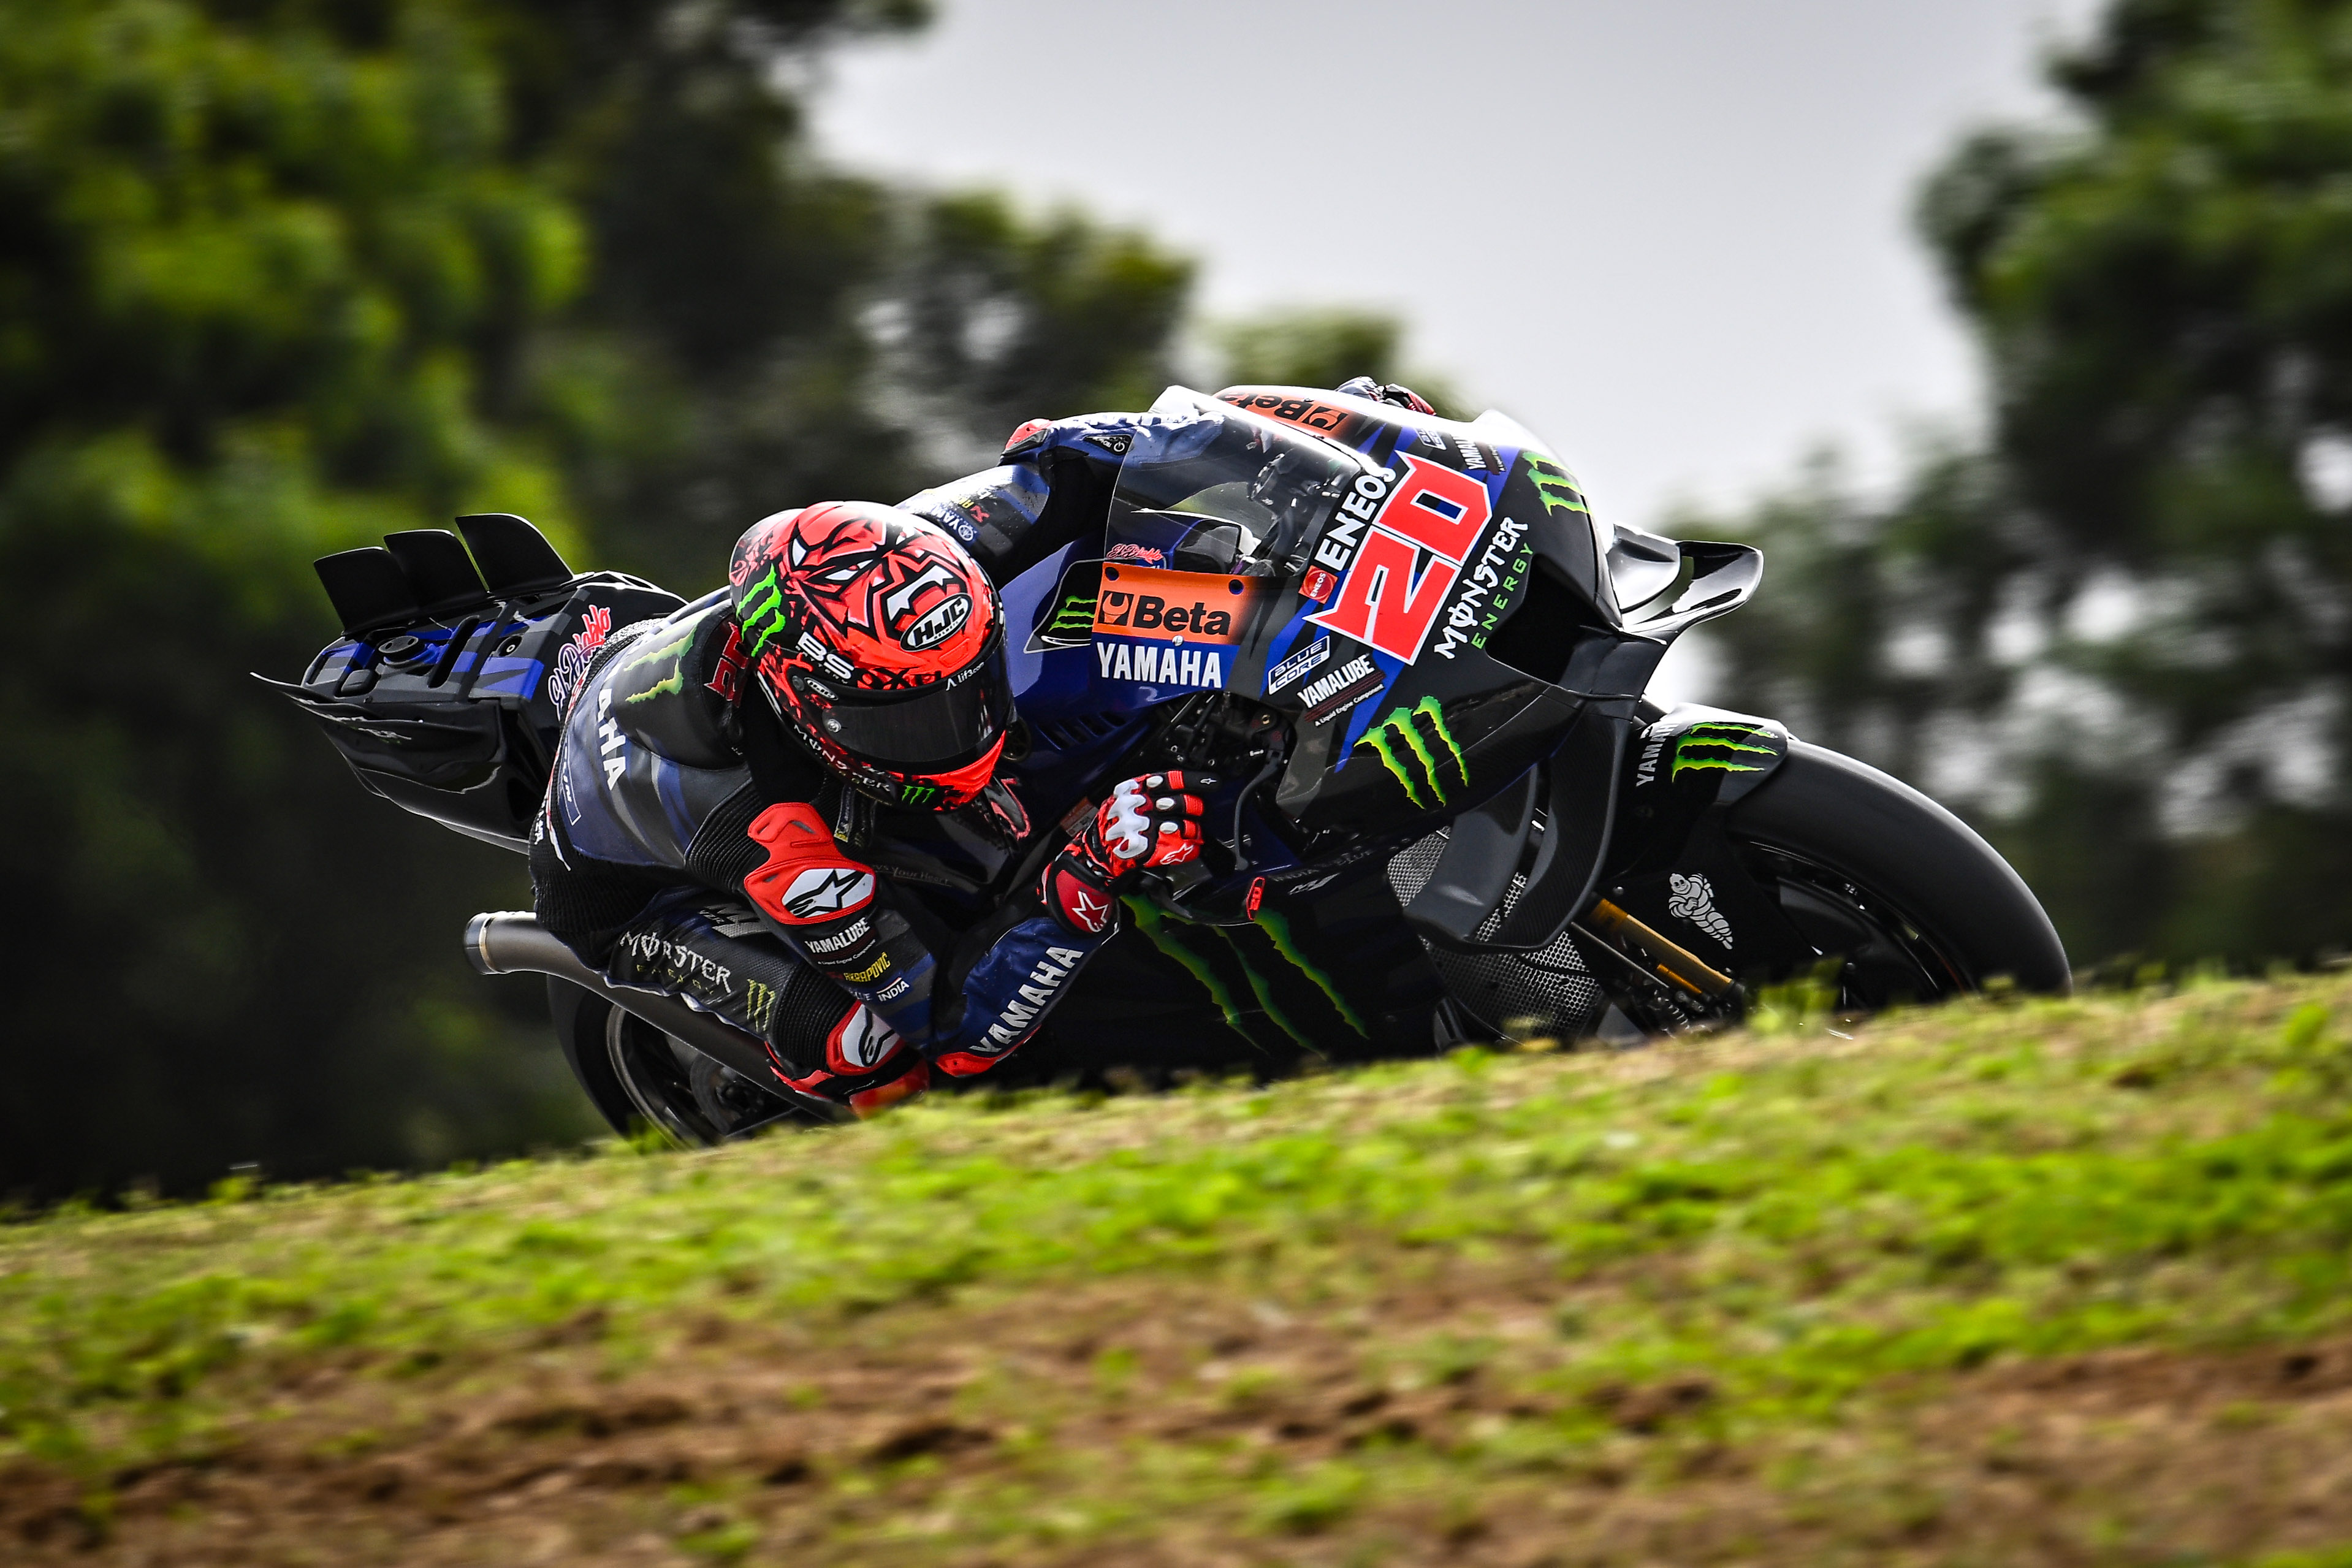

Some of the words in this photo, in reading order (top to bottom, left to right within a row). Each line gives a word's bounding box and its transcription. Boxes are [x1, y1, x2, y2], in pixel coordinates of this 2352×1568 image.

[1314, 467, 1398, 571] ENEOS
[1303, 451, 1493, 666] 20
[1310, 571, 1326, 598] ENEOS
[1434, 517, 1528, 660] MONSTER
[1471, 542, 1533, 649] ENERGY
[913, 598, 965, 646] HJC
[1133, 595, 1231, 636] Beta
[797, 631, 854, 679] BS
[1097, 642, 1222, 688] YAMAHA
[1274, 642, 1323, 677] BLUE
[1275, 654, 1322, 688] CORE
[1297, 655, 1375, 708] YAMALUBE
[1336, 701, 1353, 715] Engine
[1353, 683, 1384, 704] Component
[805, 917, 870, 953] YAMALUBE
[878, 981, 910, 1002] INDIA
[969, 946, 1084, 1052] YAMAHA
